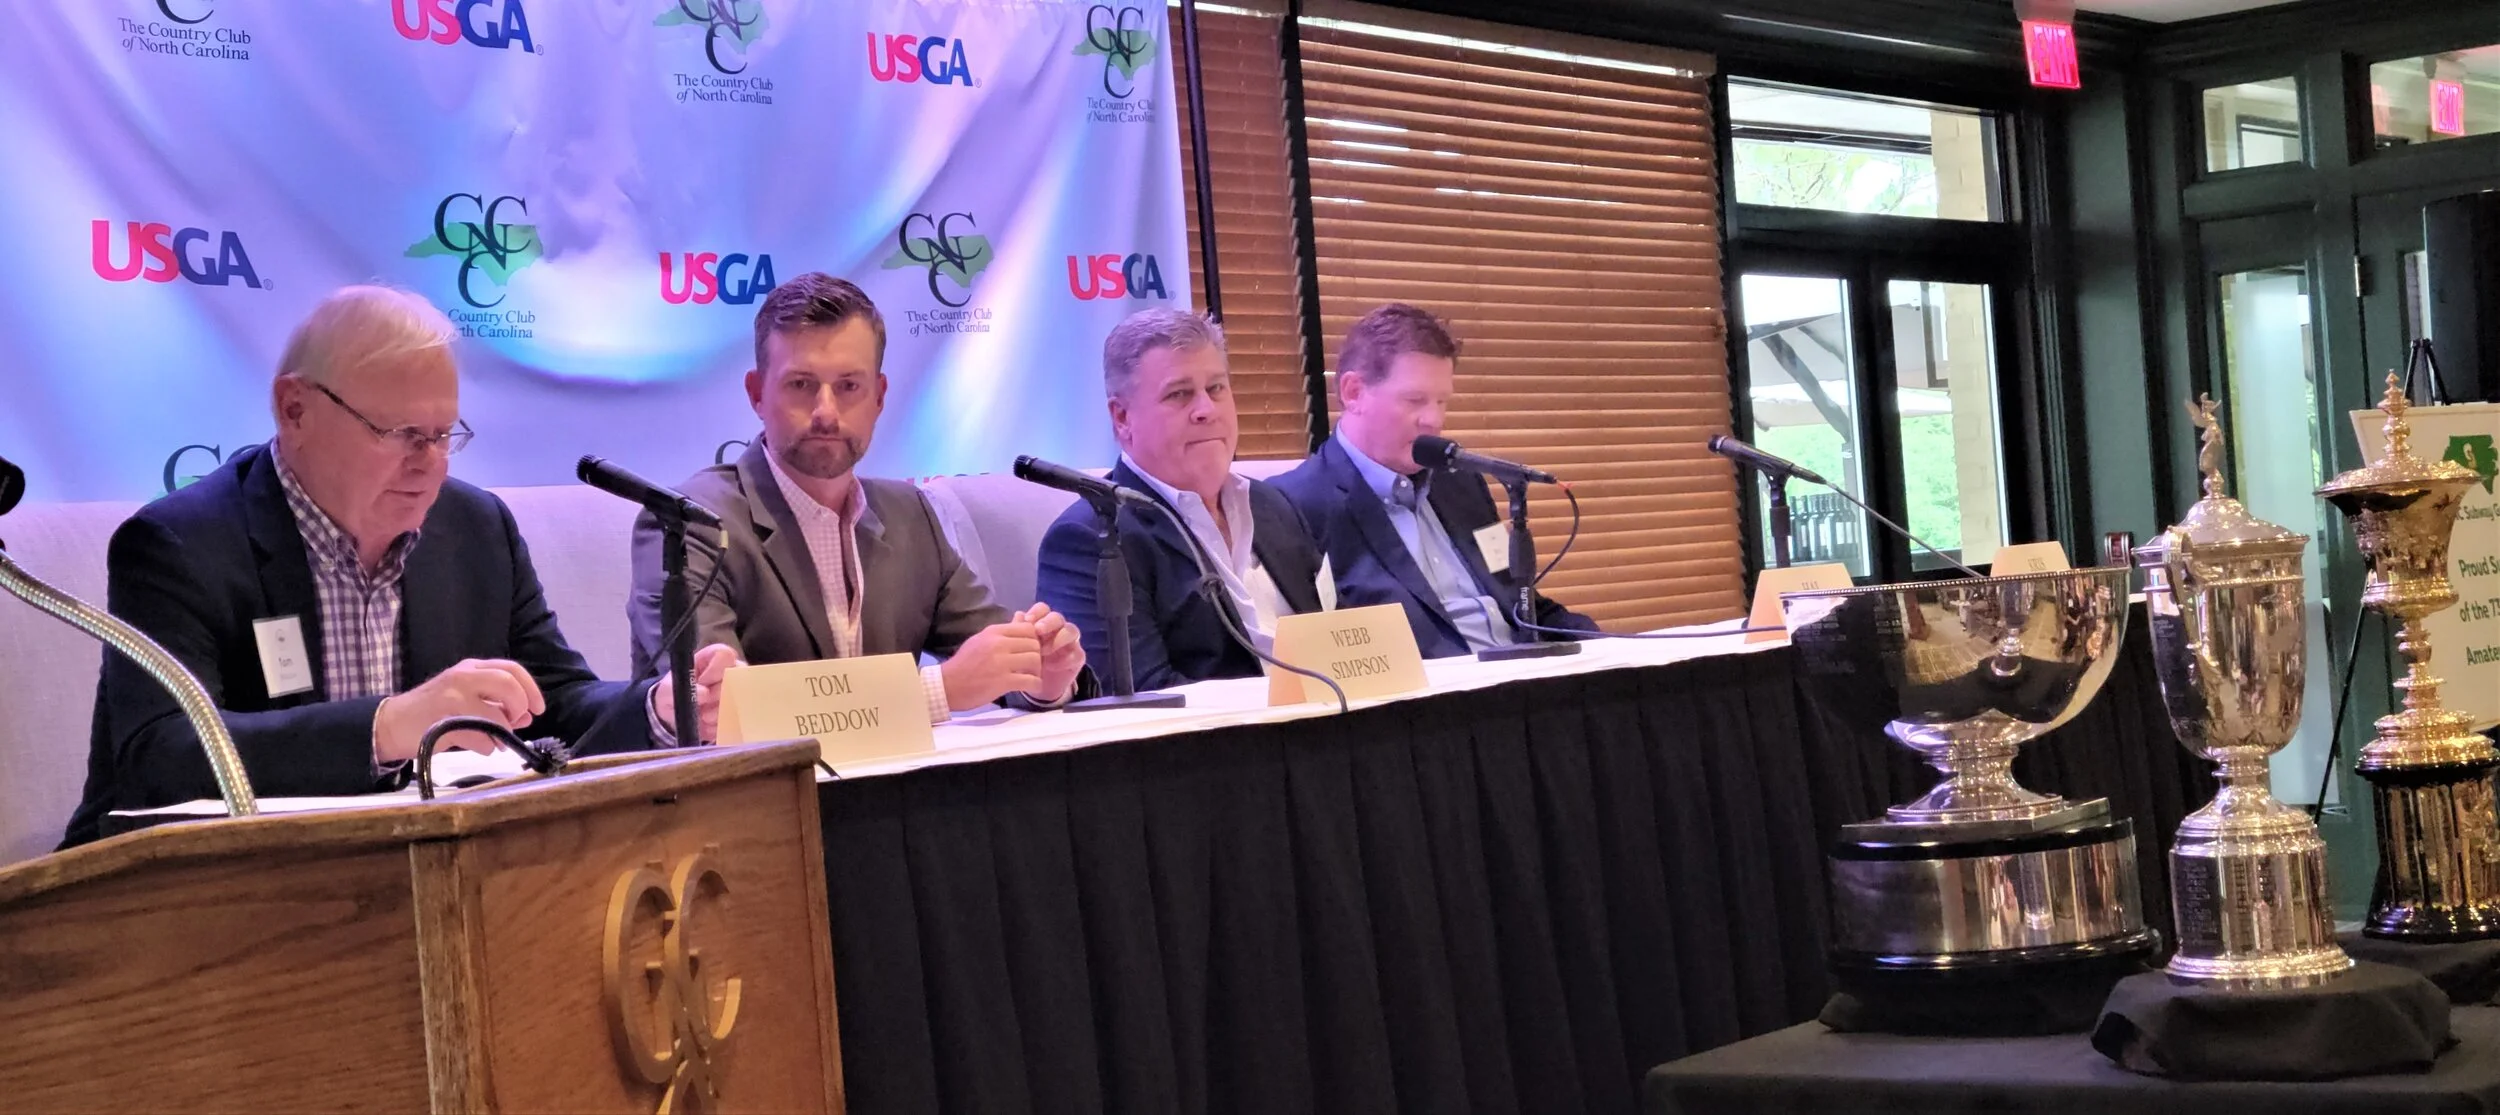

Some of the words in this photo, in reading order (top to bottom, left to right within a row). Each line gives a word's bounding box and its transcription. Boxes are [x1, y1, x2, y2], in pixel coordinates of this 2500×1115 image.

[118, 17, 145, 34] The
[148, 22, 211, 44] Country
[215, 28, 251, 44] Club
[122, 36, 135, 52] of
[134, 37, 178, 55] North
[182, 42, 249, 60] Carolina
[867, 32, 973, 86] USGA
[674, 73, 698, 86] The
[701, 74, 748, 91] Country
[750, 77, 773, 91] Club
[676, 88, 690, 104] of
[692, 89, 727, 102] North
[729, 89, 772, 104] Carolina
[1099, 98, 1136, 113] Country
[1093, 110, 1117, 122] North
[92, 220, 262, 288] USGA
[660, 252, 776, 305] USGA
[1067, 253, 1168, 299] USGA
[448, 309, 502, 325] Country
[505, 310, 536, 323] Club
[905, 310, 928, 322] The
[930, 309, 973, 322] Country
[974, 308, 992, 320] Club
[477, 325, 533, 338] Carolina
[909, 323, 921, 337] of
[923, 323, 955, 333] North
[957, 321, 990, 333] Carolina
[2458, 557, 2489, 578] Proud
[2460, 601, 2471, 622] of
[2471, 600, 2489, 620] the
[1330, 627, 1371, 647] WEBB
[1331, 655, 1390, 679] SIMPSON
[805, 674, 852, 697] TOM
[795, 706, 879, 736] BEDDOW
